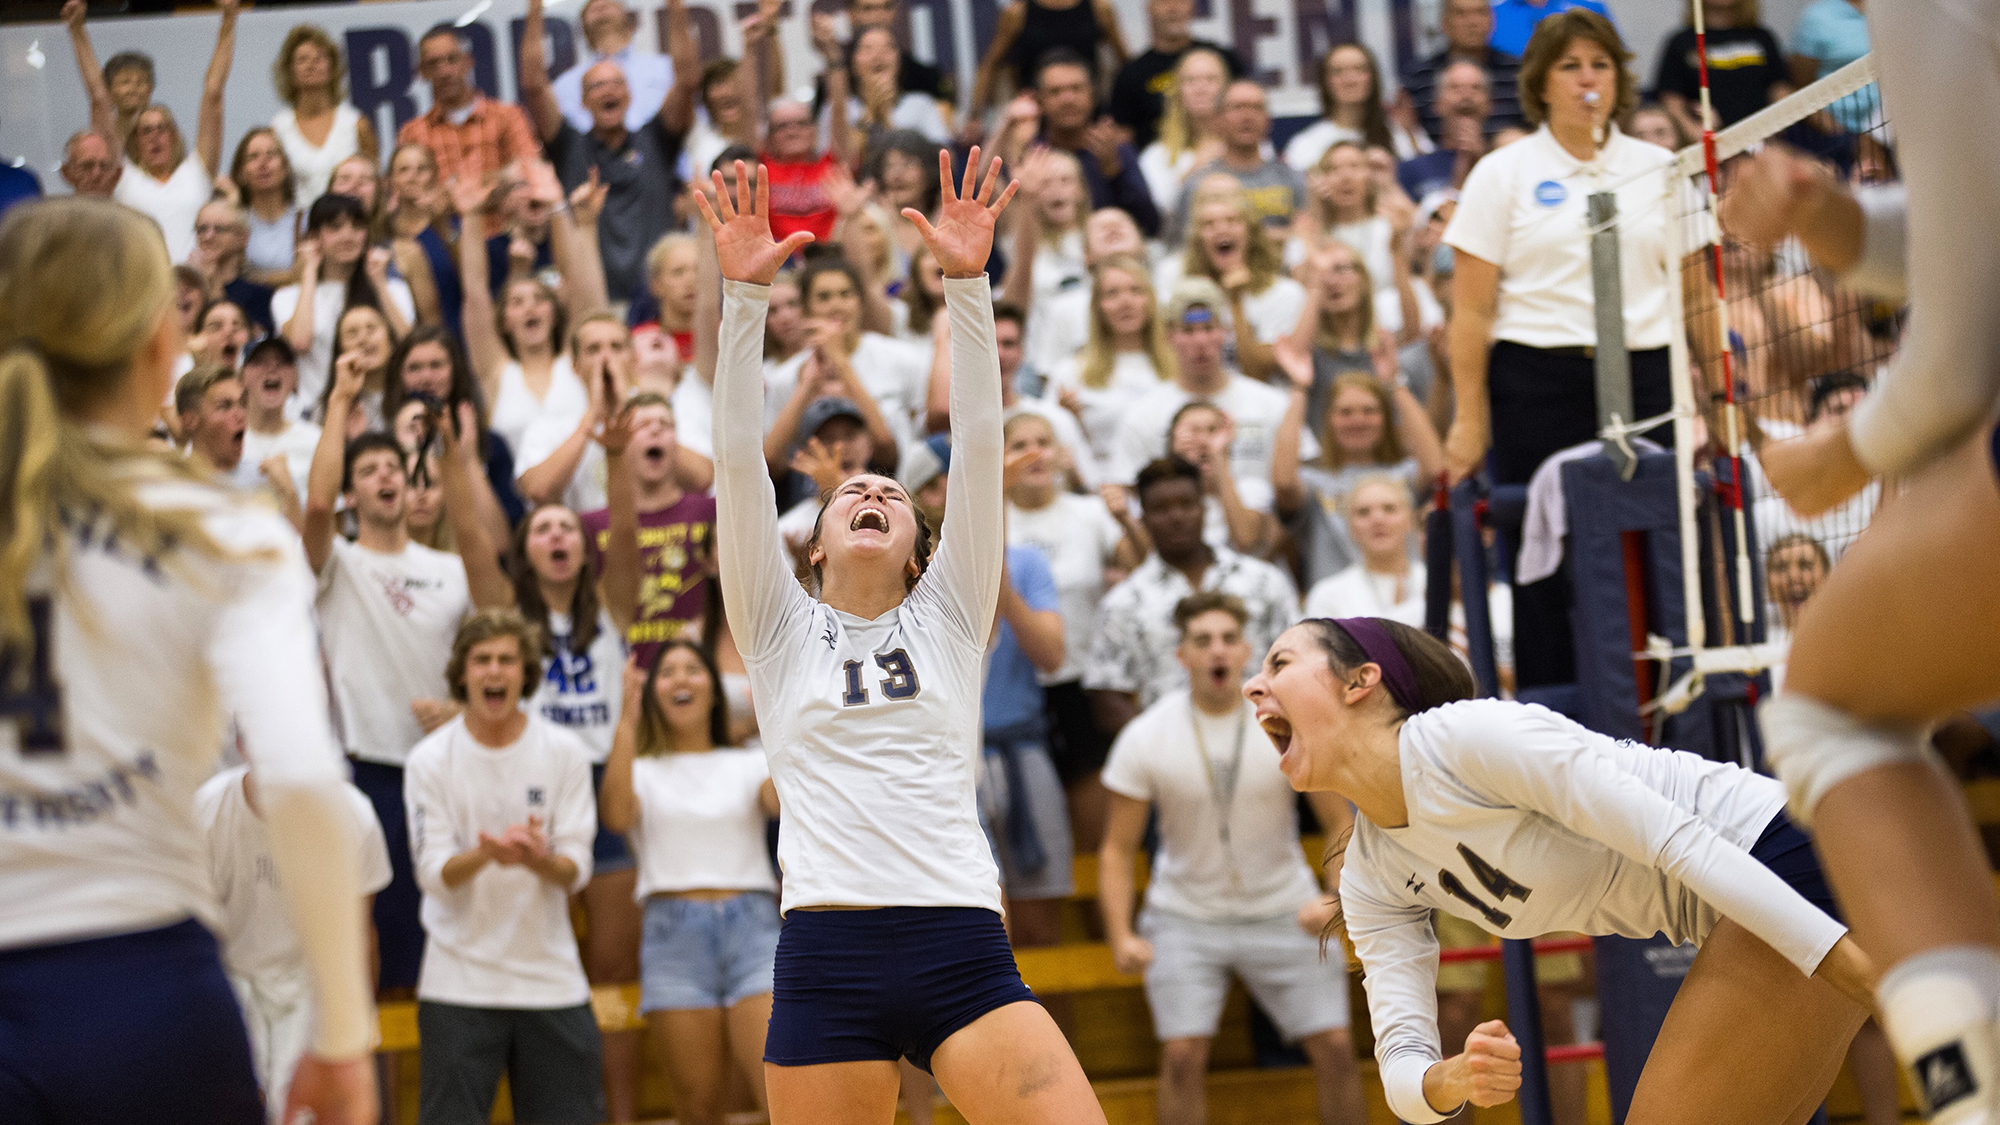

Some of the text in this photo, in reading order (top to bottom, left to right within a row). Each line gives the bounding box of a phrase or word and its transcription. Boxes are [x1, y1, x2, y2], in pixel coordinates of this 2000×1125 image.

[547, 654, 597, 694] 42
[842, 647, 922, 708] 13
[1437, 841, 1533, 930] 14
